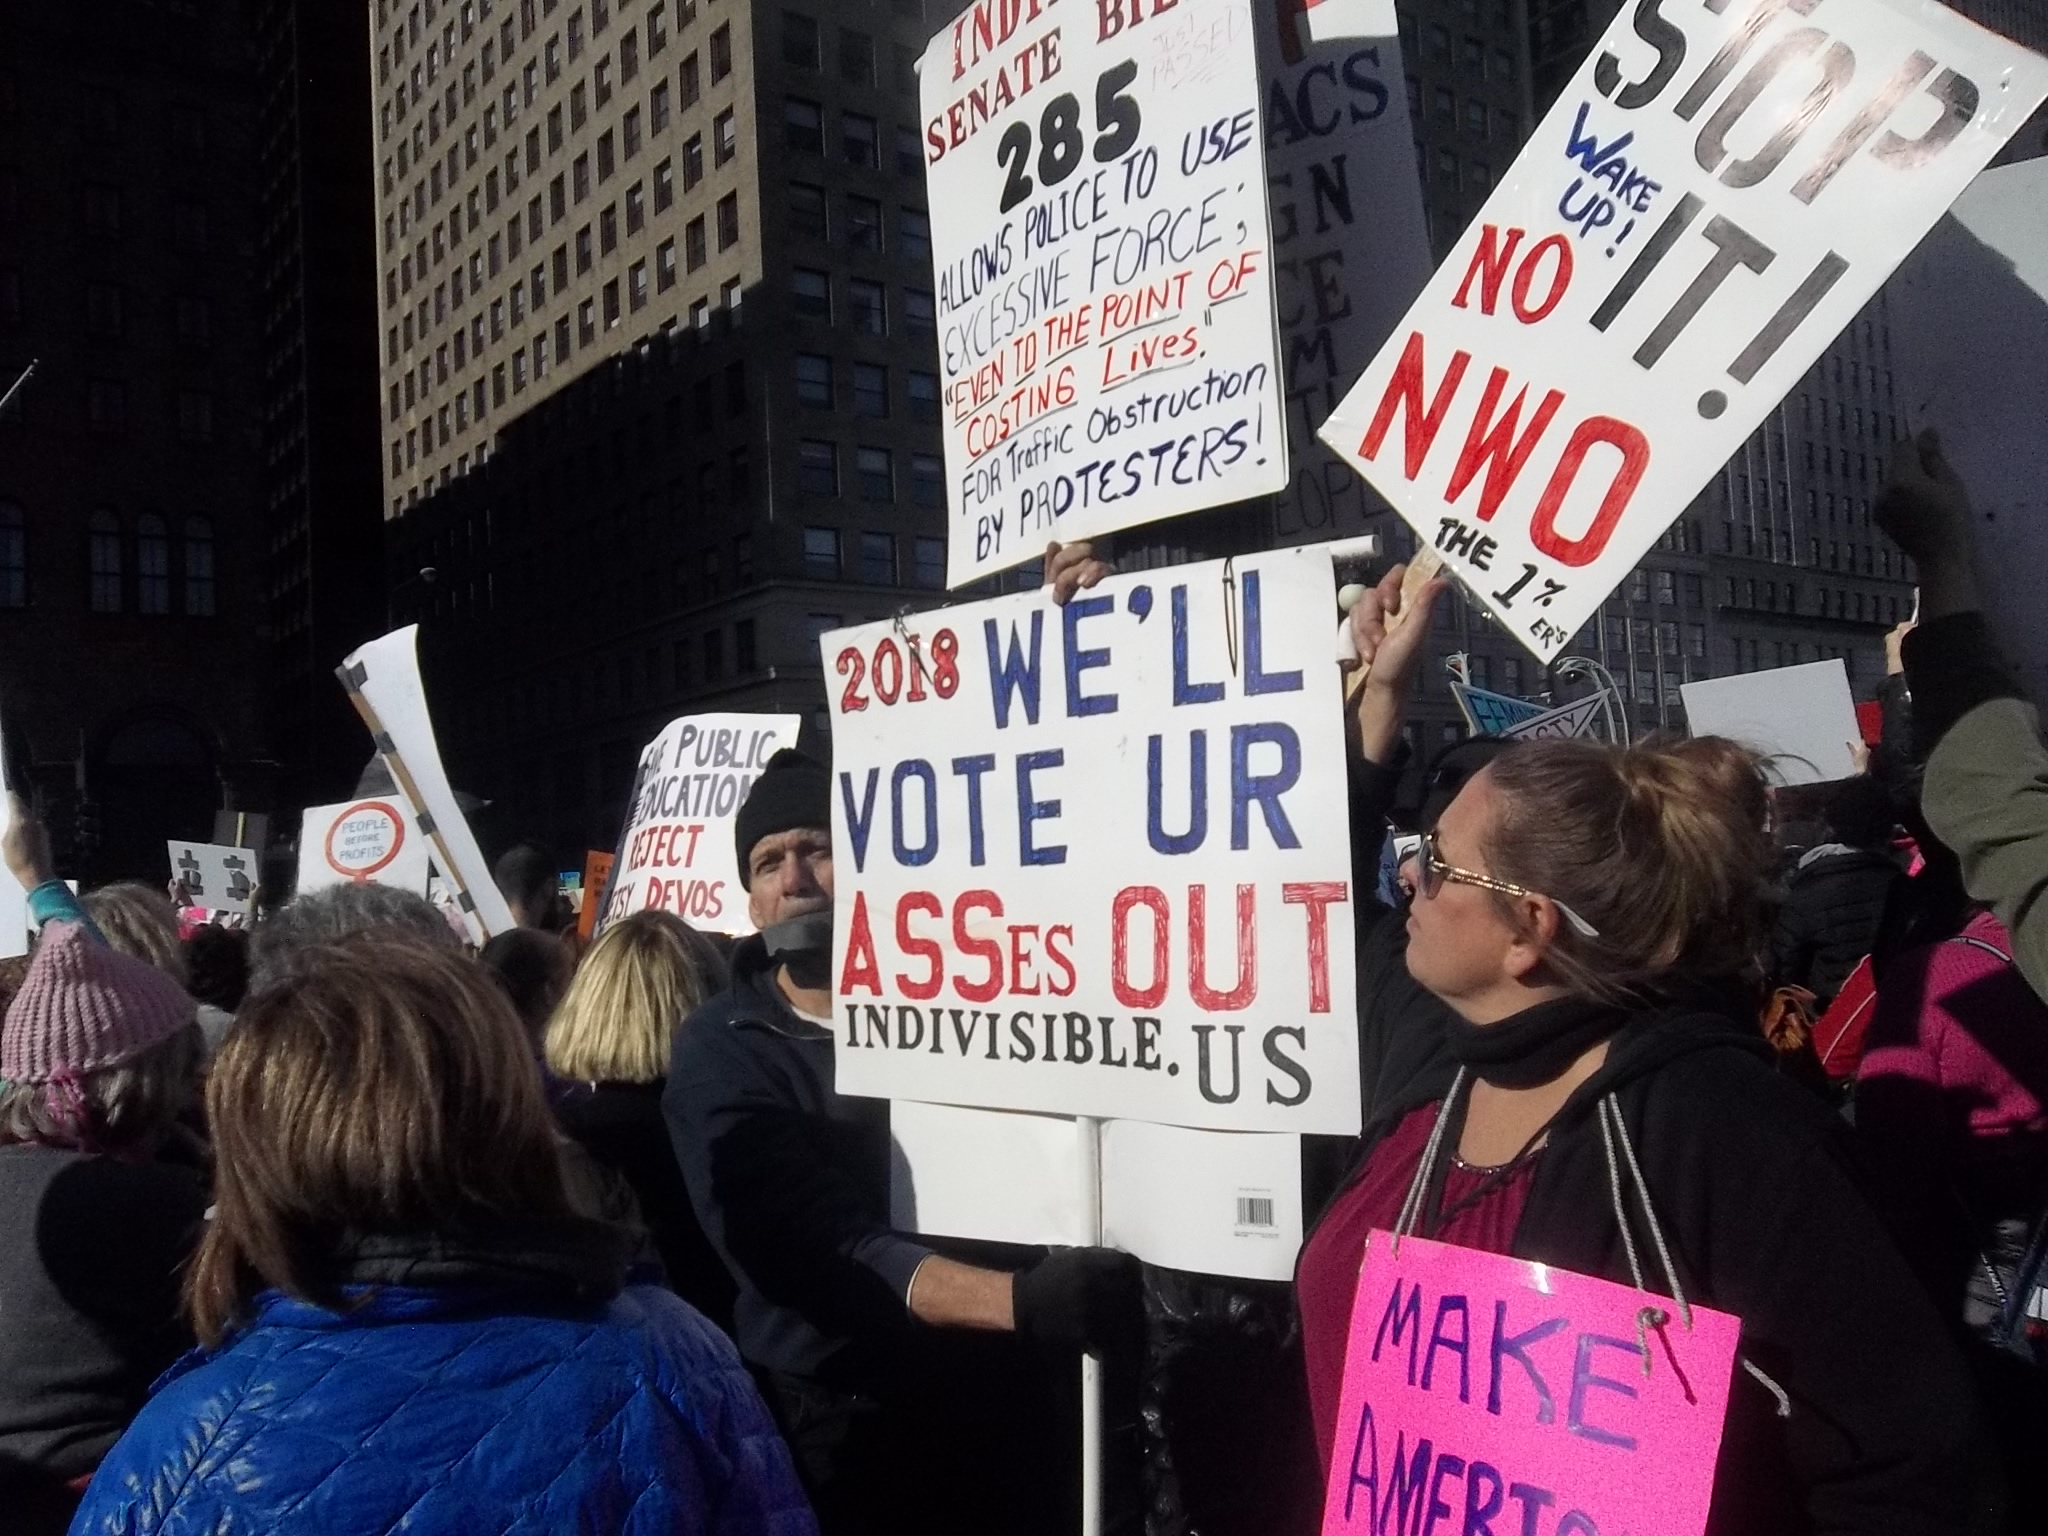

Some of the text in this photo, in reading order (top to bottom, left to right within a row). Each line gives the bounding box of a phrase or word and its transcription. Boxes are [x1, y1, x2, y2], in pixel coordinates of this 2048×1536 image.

[927, 26, 1062, 166] SENATE
[952, 0, 1054, 82] IND
[1594, 0, 1980, 206] STOP
[997, 58, 1141, 214] 285
[1565, 100, 1663, 213] WAKE
[940, 108, 1256, 318] ALLOWS POLICE TO USE
[1451, 223, 1574, 325] NO
[1558, 176, 1636, 259] UP!
[944, 249, 1070, 377] EXCESSIVE
[1013, 331, 1038, 378] TO
[1044, 304, 1092, 356] THE
[1100, 271, 1193, 337] POINT
[1207, 250, 1263, 301] OF
[1589, 191, 1851, 420] IT!
[962, 362, 1267, 515] FOR Traffic Obstruction
[967, 366, 1076, 458] COSTING
[1357, 331, 1652, 568] NWO
[976, 401, 1266, 562] BY PROTESTERS!
[1434, 516, 1499, 572] THE
[835, 569, 1305, 729] 2018 WE'LL
[674, 723, 777, 770] PUBLIC
[838, 721, 1303, 873] VOTE UR
[340, 845, 386, 861] PROFITS
[341, 817, 389, 835] PEOPLE
[627, 824, 705, 873] REJECT
[644, 876, 726, 919] DEVOS
[1110, 881, 1349, 1014] OUT
[1371, 1278, 1645, 1451] MAKE
[1345, 1402, 1627, 1536] AMERI
